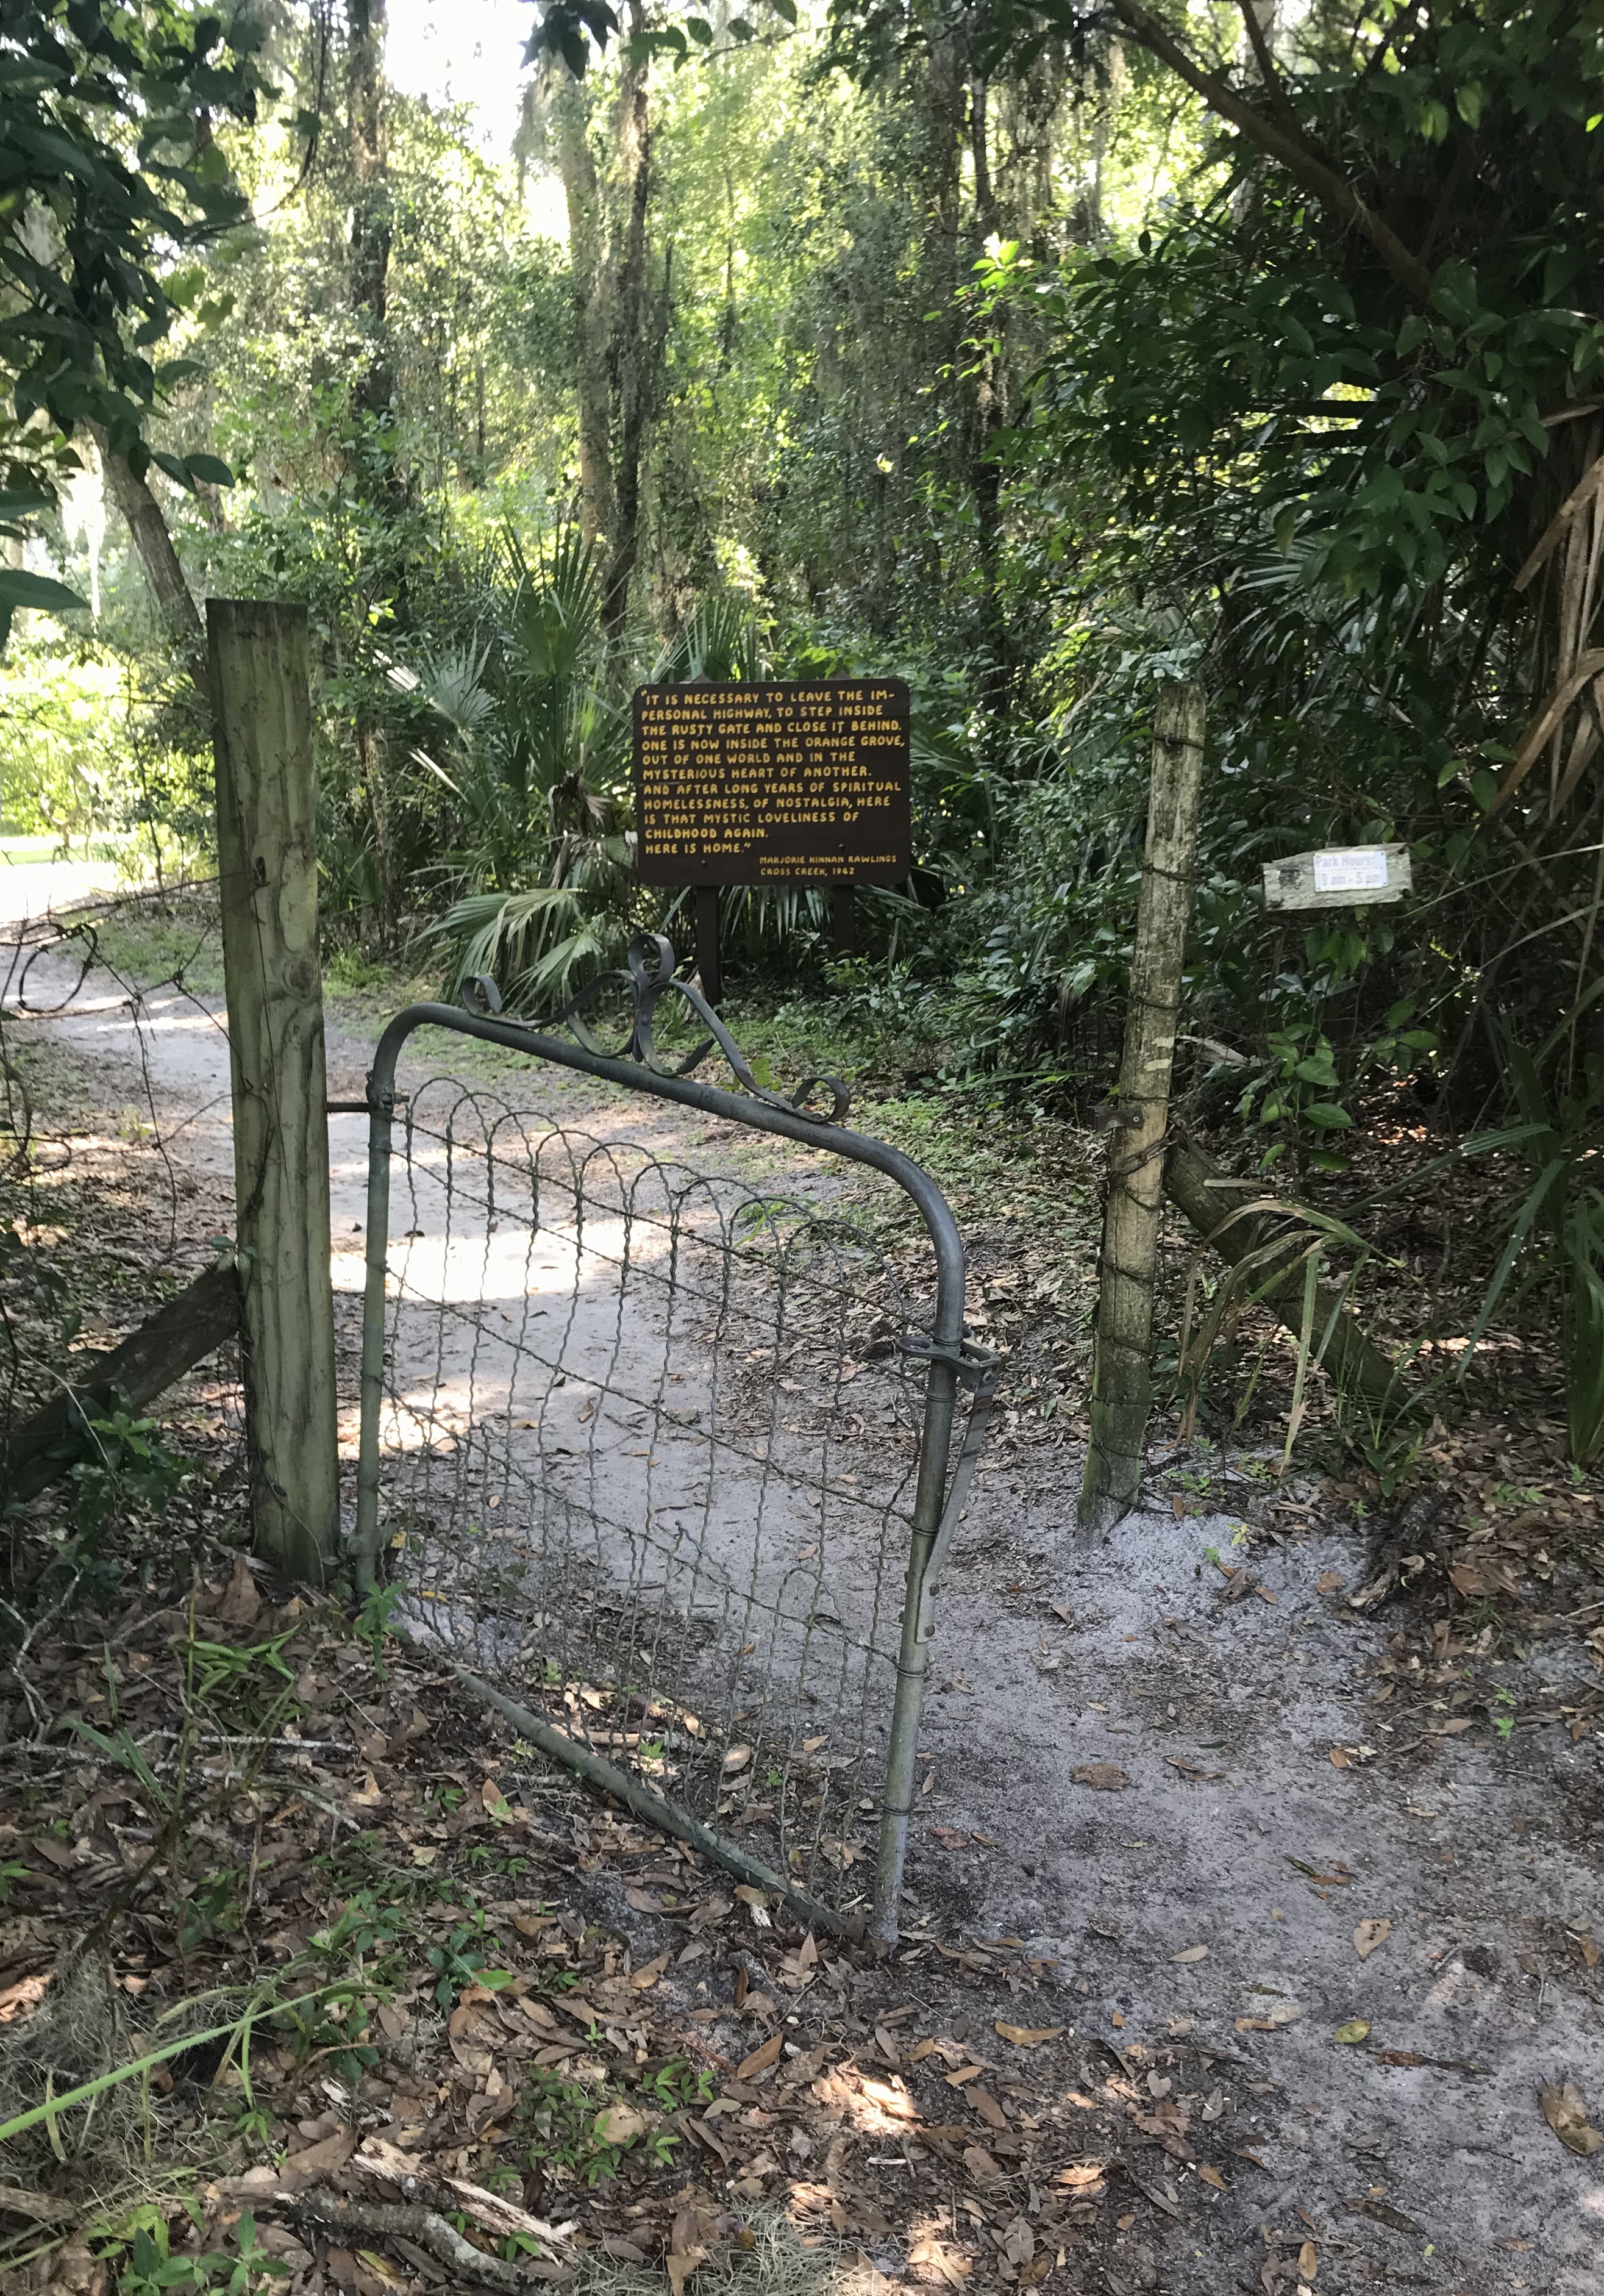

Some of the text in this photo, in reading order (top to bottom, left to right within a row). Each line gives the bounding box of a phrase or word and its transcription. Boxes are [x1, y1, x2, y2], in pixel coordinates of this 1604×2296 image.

[665, 695, 677, 705] IS
[684, 693, 758, 704] NECESSARY
[767, 692, 783, 702] TO
[791, 692, 830, 701] LEAVE
[838, 690, 862, 701] THE
[871, 690, 894, 699] IM-
[641, 705, 882, 721] PERSONAL HIGHWAY, TO STEP INSIDE
[643, 720, 902, 736] THE RUSTY GATE AND CLOSE IT BEHIND.
[641, 735, 905, 751] ONE IS NOW INSIDE THE ORANGE GROVE,
[643, 751, 854, 765] OUT OF ONE WORLD AND IN THE
[643, 765, 872, 779] MYSTERIOUS HEART OF ANOTHER.
[644, 781, 900, 795] AND AFTER LONG YEARS OF SPIRITUAL
[644, 796, 889, 811] HOMELESSNESS, OF NOSTALGIA, HERE
[644, 812, 858, 824] IS THAT MYSTIC LOVELINESS OF
[645, 828, 768, 839] CHILDHOOD AGAIN.
[646, 843, 677, 854] HERE
[685, 843, 696, 854] IS
[1316, 855, 1338, 867] Park
[796, 868, 827, 877] CREEK,
[1322, 874, 1327, 885] 9
[1330, 876, 1346, 885] am
[1356, 871, 1362, 884] 5
[1366, 874, 1380, 885] pm
